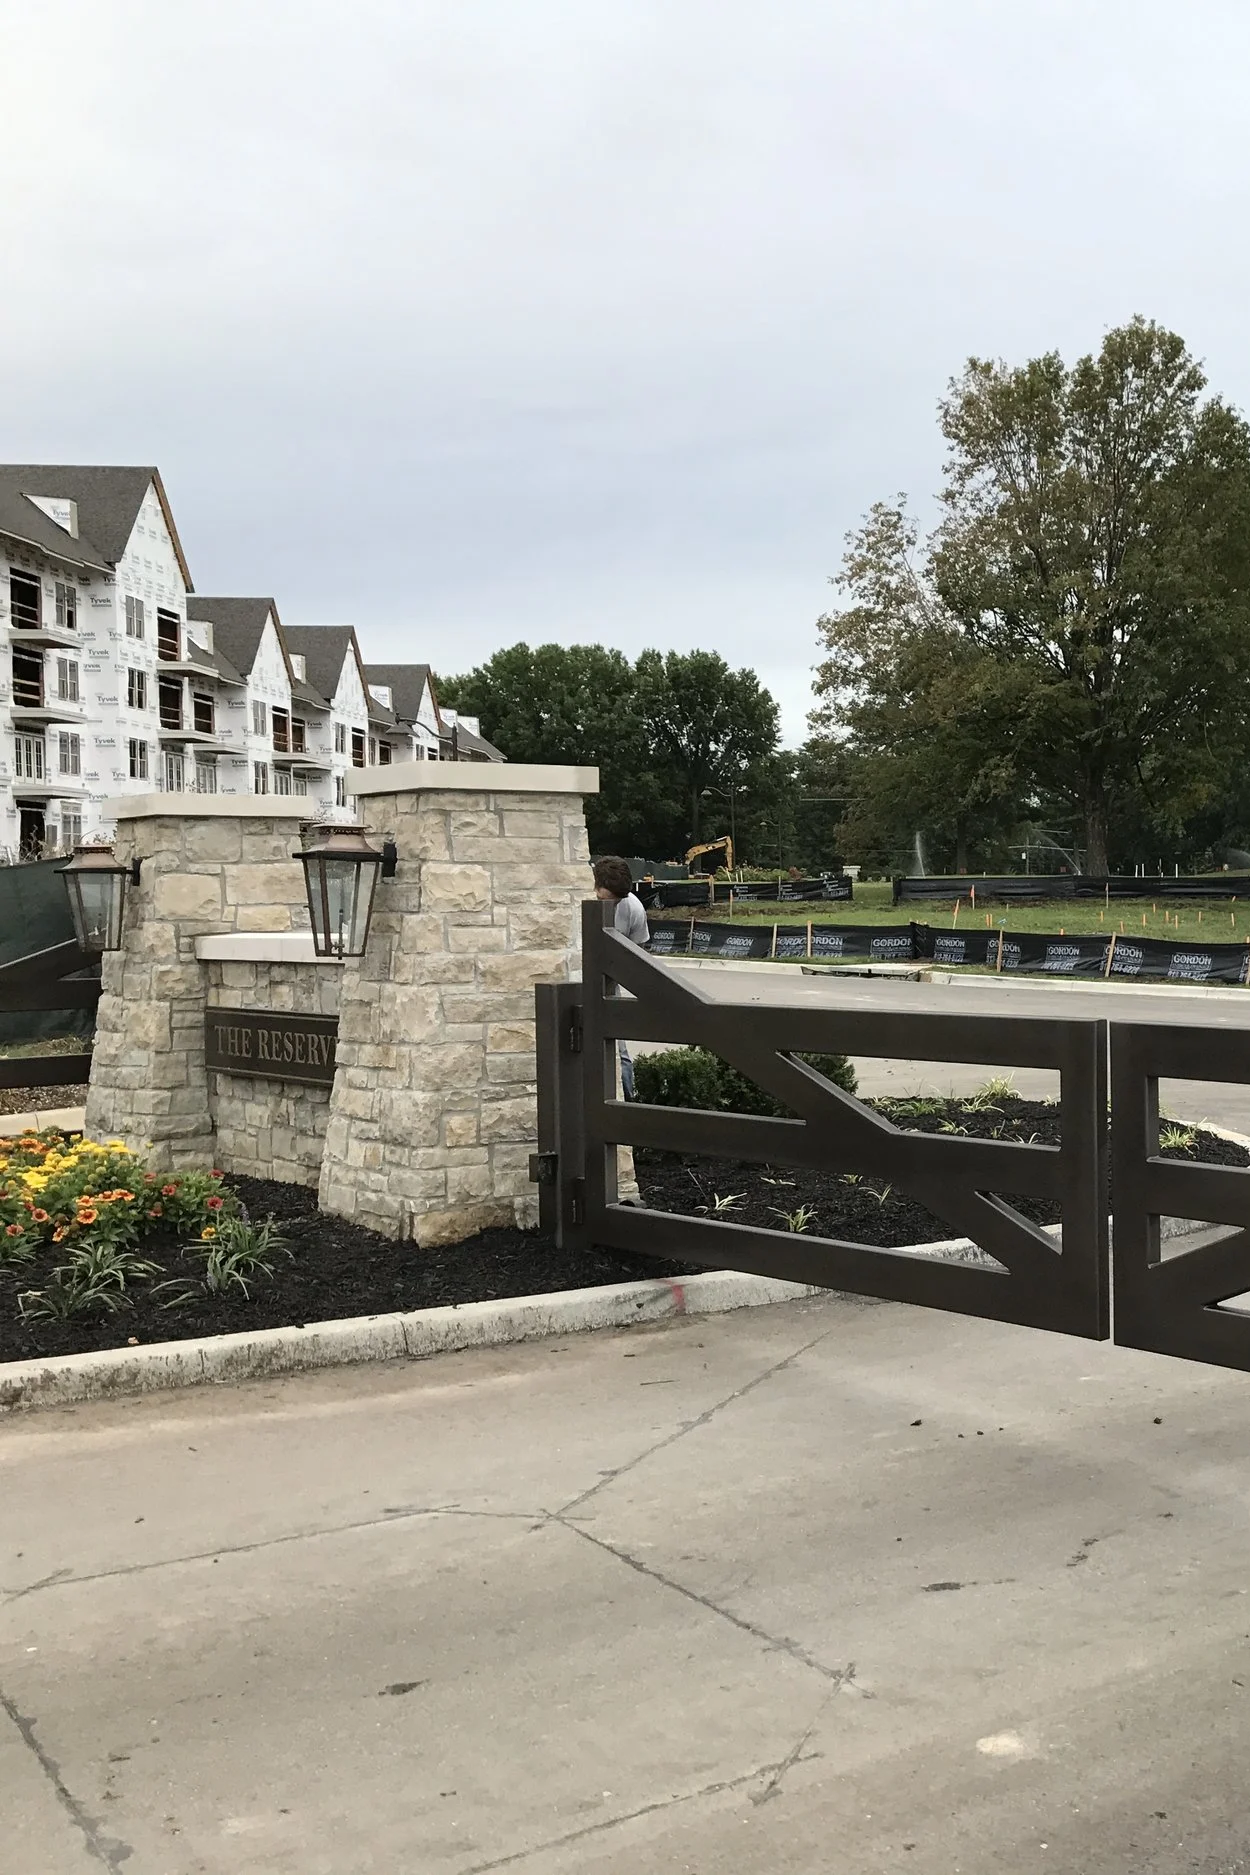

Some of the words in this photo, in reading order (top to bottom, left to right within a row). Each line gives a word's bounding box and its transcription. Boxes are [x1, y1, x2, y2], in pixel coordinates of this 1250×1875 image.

[726, 936, 754, 946] GORDON
[1048, 946, 1080, 955] GORDON
[1173, 954, 1212, 965] GORDON
[214, 1024, 253, 1058] THE
